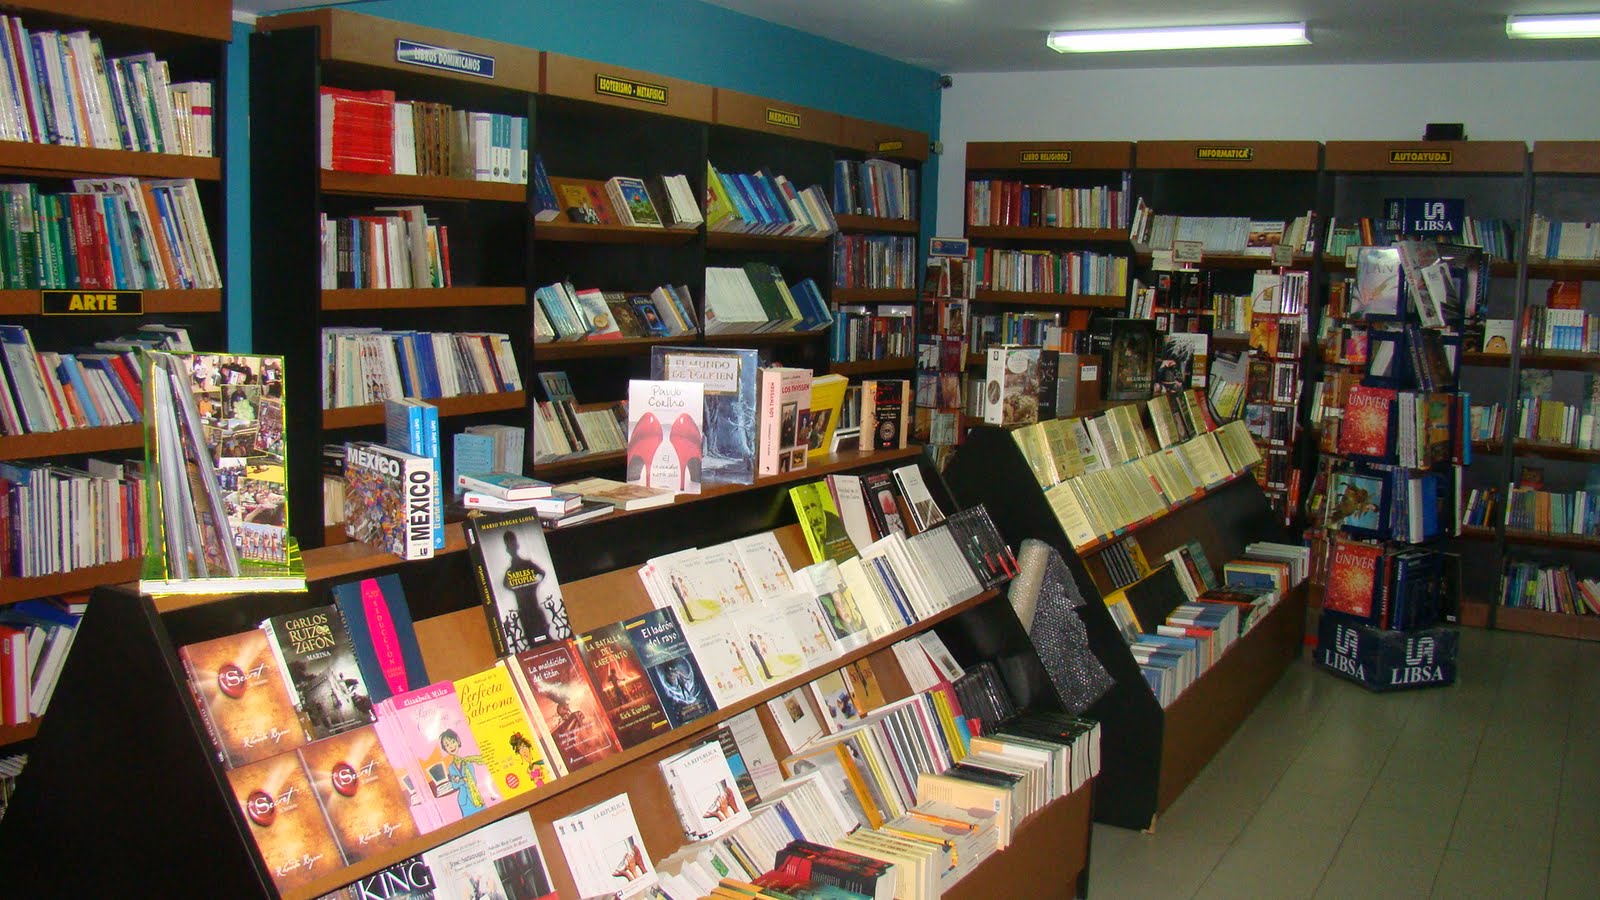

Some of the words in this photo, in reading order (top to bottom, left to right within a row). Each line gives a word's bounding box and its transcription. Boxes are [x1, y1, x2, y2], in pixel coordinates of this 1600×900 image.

[414, 47, 438, 64] LIBROS
[439, 49, 481, 72] DOMINICANOS
[599, 78, 632, 95] ESOTERISMO
[637, 85, 665, 101] METAFISICA
[768, 111, 798, 126] MEDICINA
[1023, 152, 1039, 161] LIBRO
[1040, 152, 1068, 161] RELIGIOSO
[1199, 148, 1248, 158] INFORMATICA
[1393, 153, 1447, 161] AUTOAYUDA
[1415, 220, 1453, 231] LIBSA
[69, 294, 117, 311] ARTE
[688, 360, 730, 369] MUNDO
[672, 370, 685, 379] DE
[688, 368, 734, 380] TOLKIEN
[652, 384, 682, 397] Paulo
[782, 385, 791, 394] LOS
[791, 384, 809, 393] THYSSEN
[648, 397, 685, 408] Coelho
[481, 522, 498, 530] MARIO
[499, 519, 518, 527] VARGAS
[1335, 552, 1375, 570] UNIVER
[507, 569, 531, 580] SABLES
[286, 613, 328, 630] CARLOS
[641, 627, 650, 639] El
[651, 620, 675, 637] ladrón
[289, 627, 318, 642] RUIZ
[649, 636, 661, 648] del
[662, 632, 677, 645] rayo
[292, 633, 336, 655] ZAFÓN
[585, 644, 594, 653] LA
[594, 633, 622, 649] BATALLA
[307, 651, 332, 661] MARINA
[594, 651, 628, 669] LABERINTO
[600, 647, 613, 658] DEL
[528, 664, 538, 674] La
[540, 656, 567, 673] maldición
[1324, 649, 1366, 681] LIBSA
[226, 663, 270, 687] Secret
[533, 673, 545, 683] del
[546, 669, 560, 681] titán
[1391, 665, 1443, 685] LIBSA
[461, 683, 504, 708] Perfecta
[338, 759, 381, 786] Secret
[254, 787, 300, 815] Secret
[359, 861, 430, 900] KING
